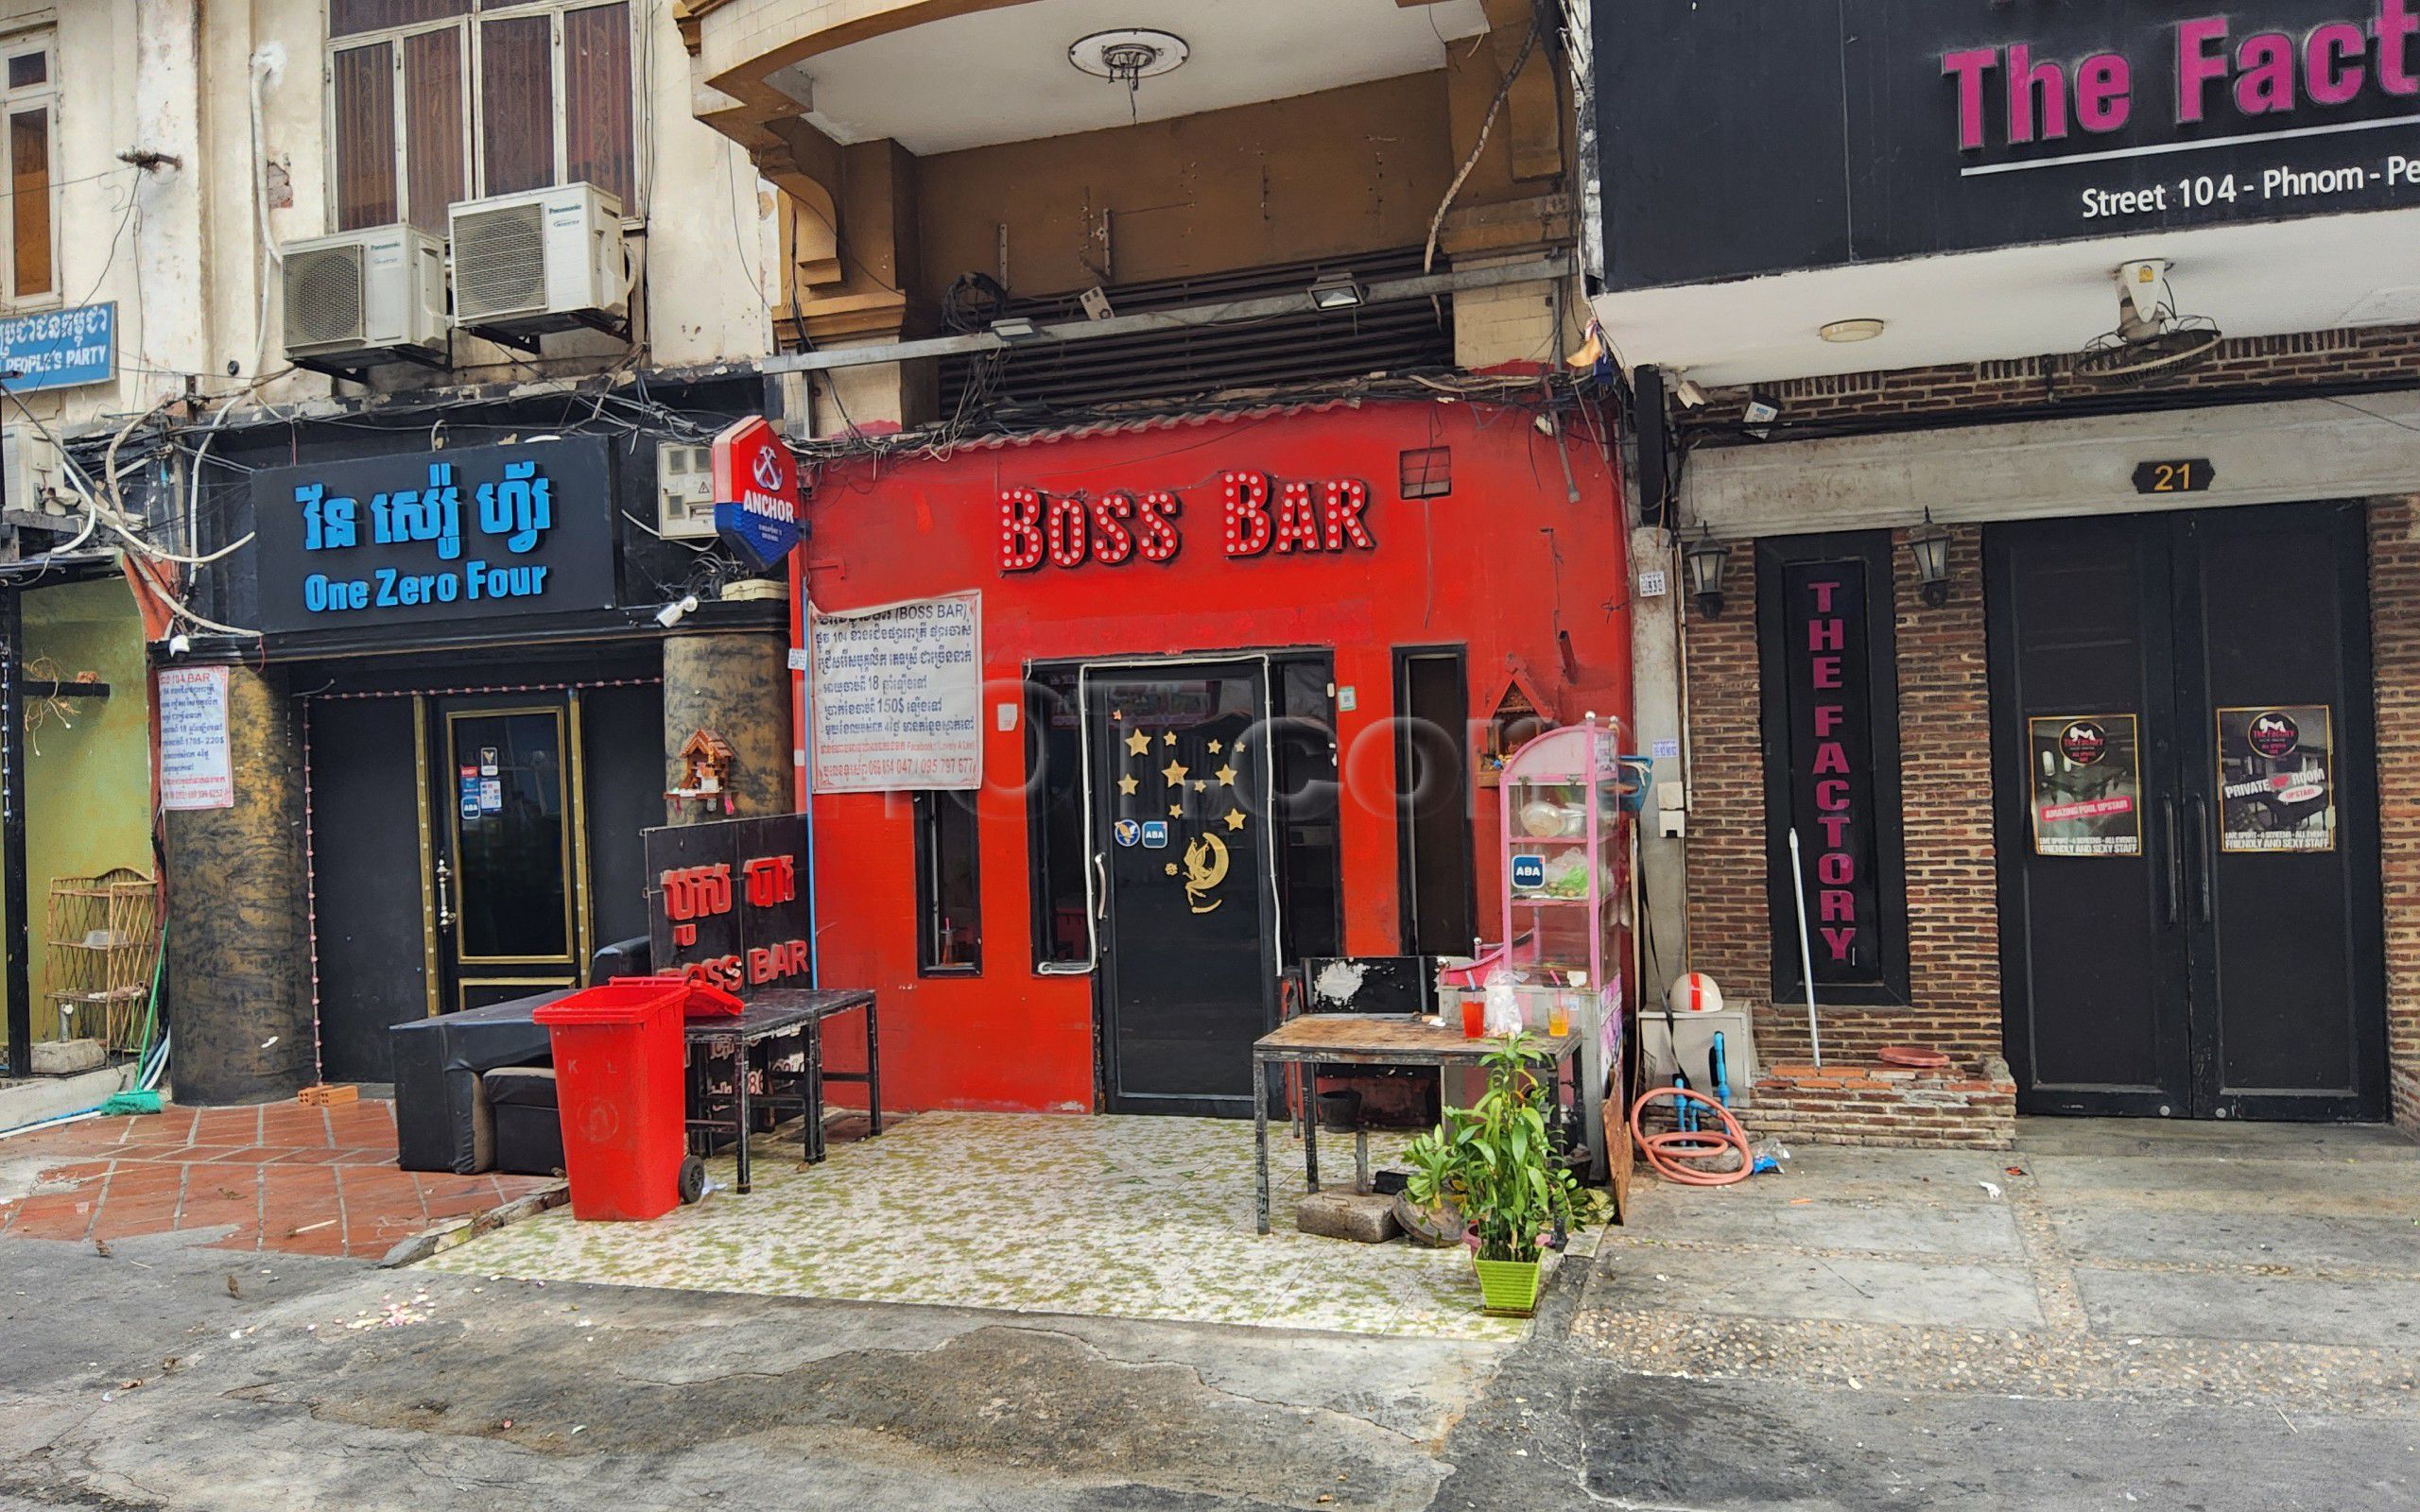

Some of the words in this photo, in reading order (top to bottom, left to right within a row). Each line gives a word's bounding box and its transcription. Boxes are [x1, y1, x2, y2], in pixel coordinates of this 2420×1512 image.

[1943, 44, 2131, 150] The
[2083, 184, 2166, 218] Street
[2178, 175, 2237, 207] 104
[2264, 165, 2363, 198] Phnom
[549, 204, 581, 215] Panasonic
[371, 242, 401, 251] Panasonic
[5, 350, 62, 373] PEOPLE'S
[65, 345, 107, 368] PARTY
[2154, 463, 2190, 491] 21
[743, 490, 794, 524] ANCHOR
[998, 488, 1179, 571] BOSS
[1224, 471, 1375, 558] BAR
[304, 573, 369, 612] One
[374, 567, 458, 607] Zero
[466, 560, 547, 600] Four
[937, 602, 968, 621] BAR)
[1807, 581, 1844, 690] THE
[187, 673, 211, 682] BAR
[869, 676, 879, 691] 18
[878, 697, 905, 714] 150$
[2224, 778, 2271, 799] PRIVATE
[2291, 767, 2325, 786] ROOM
[1146, 831, 1164, 839] ABA
[1811, 705, 1856, 961] FACTORY
[2263, 839, 2282, 848] AND
[2283, 839, 2305, 848] SEXY
[2306, 838, 2329, 847] STAFF
[2092, 845, 2114, 853] SEXY
[2114, 844, 2137, 852] STAFF
[1515, 866, 1541, 877] ABA
[657, 954, 743, 992] OSS
[748, 939, 810, 986] BAR
